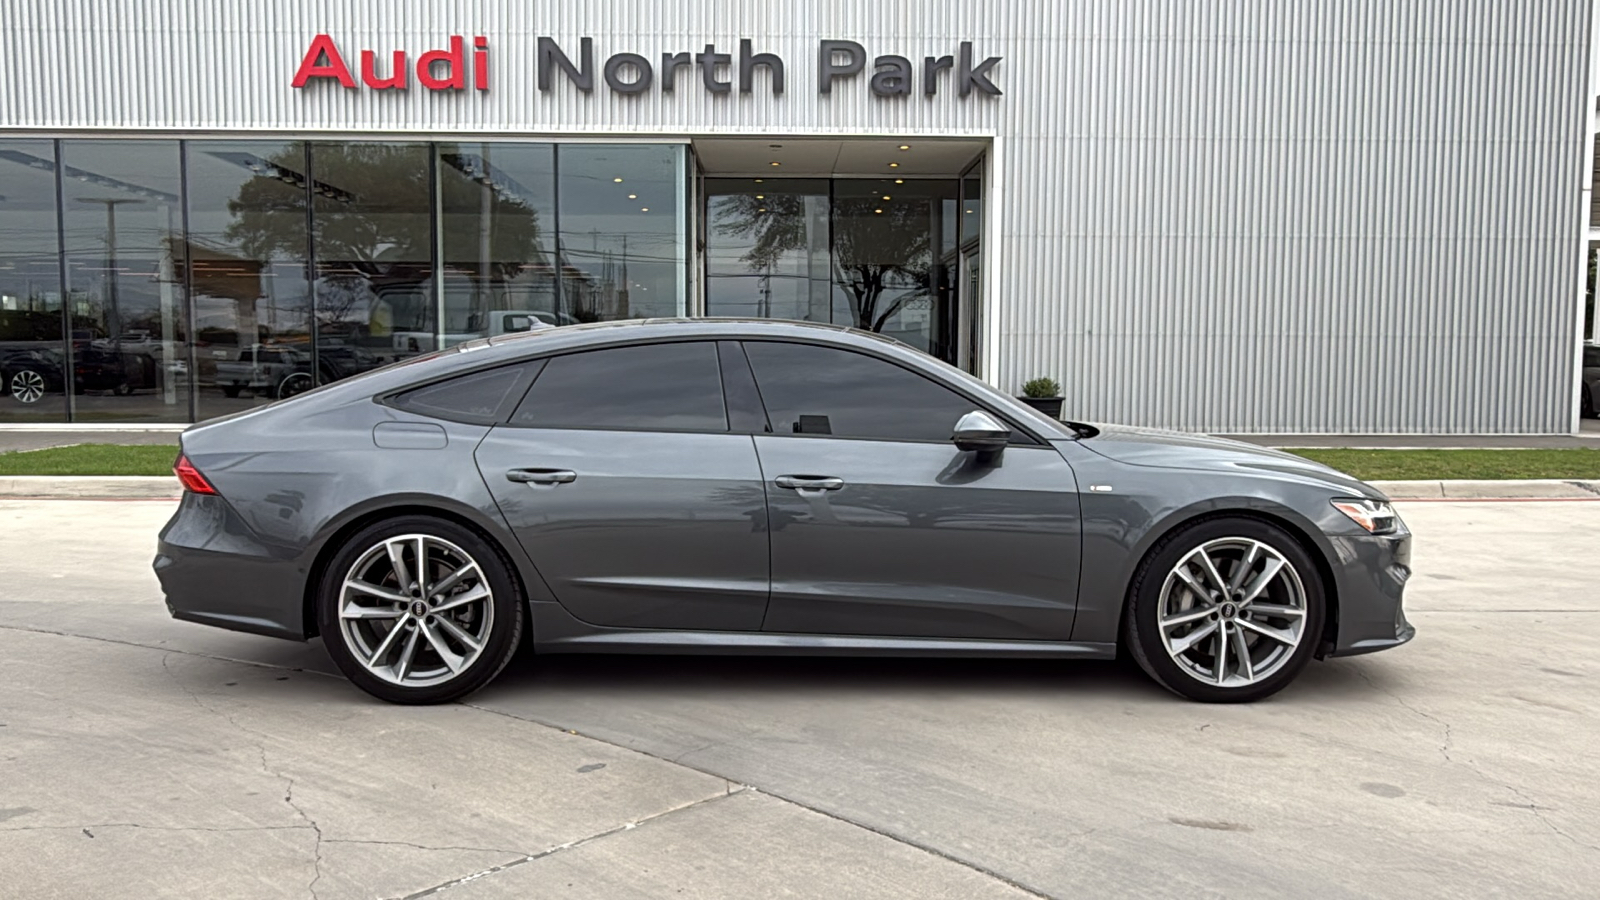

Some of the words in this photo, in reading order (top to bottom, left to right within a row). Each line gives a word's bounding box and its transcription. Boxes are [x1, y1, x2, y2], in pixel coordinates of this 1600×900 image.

[291, 34, 488, 90] Audi
[537, 37, 784, 95] North
[820, 39, 1003, 98] Park
